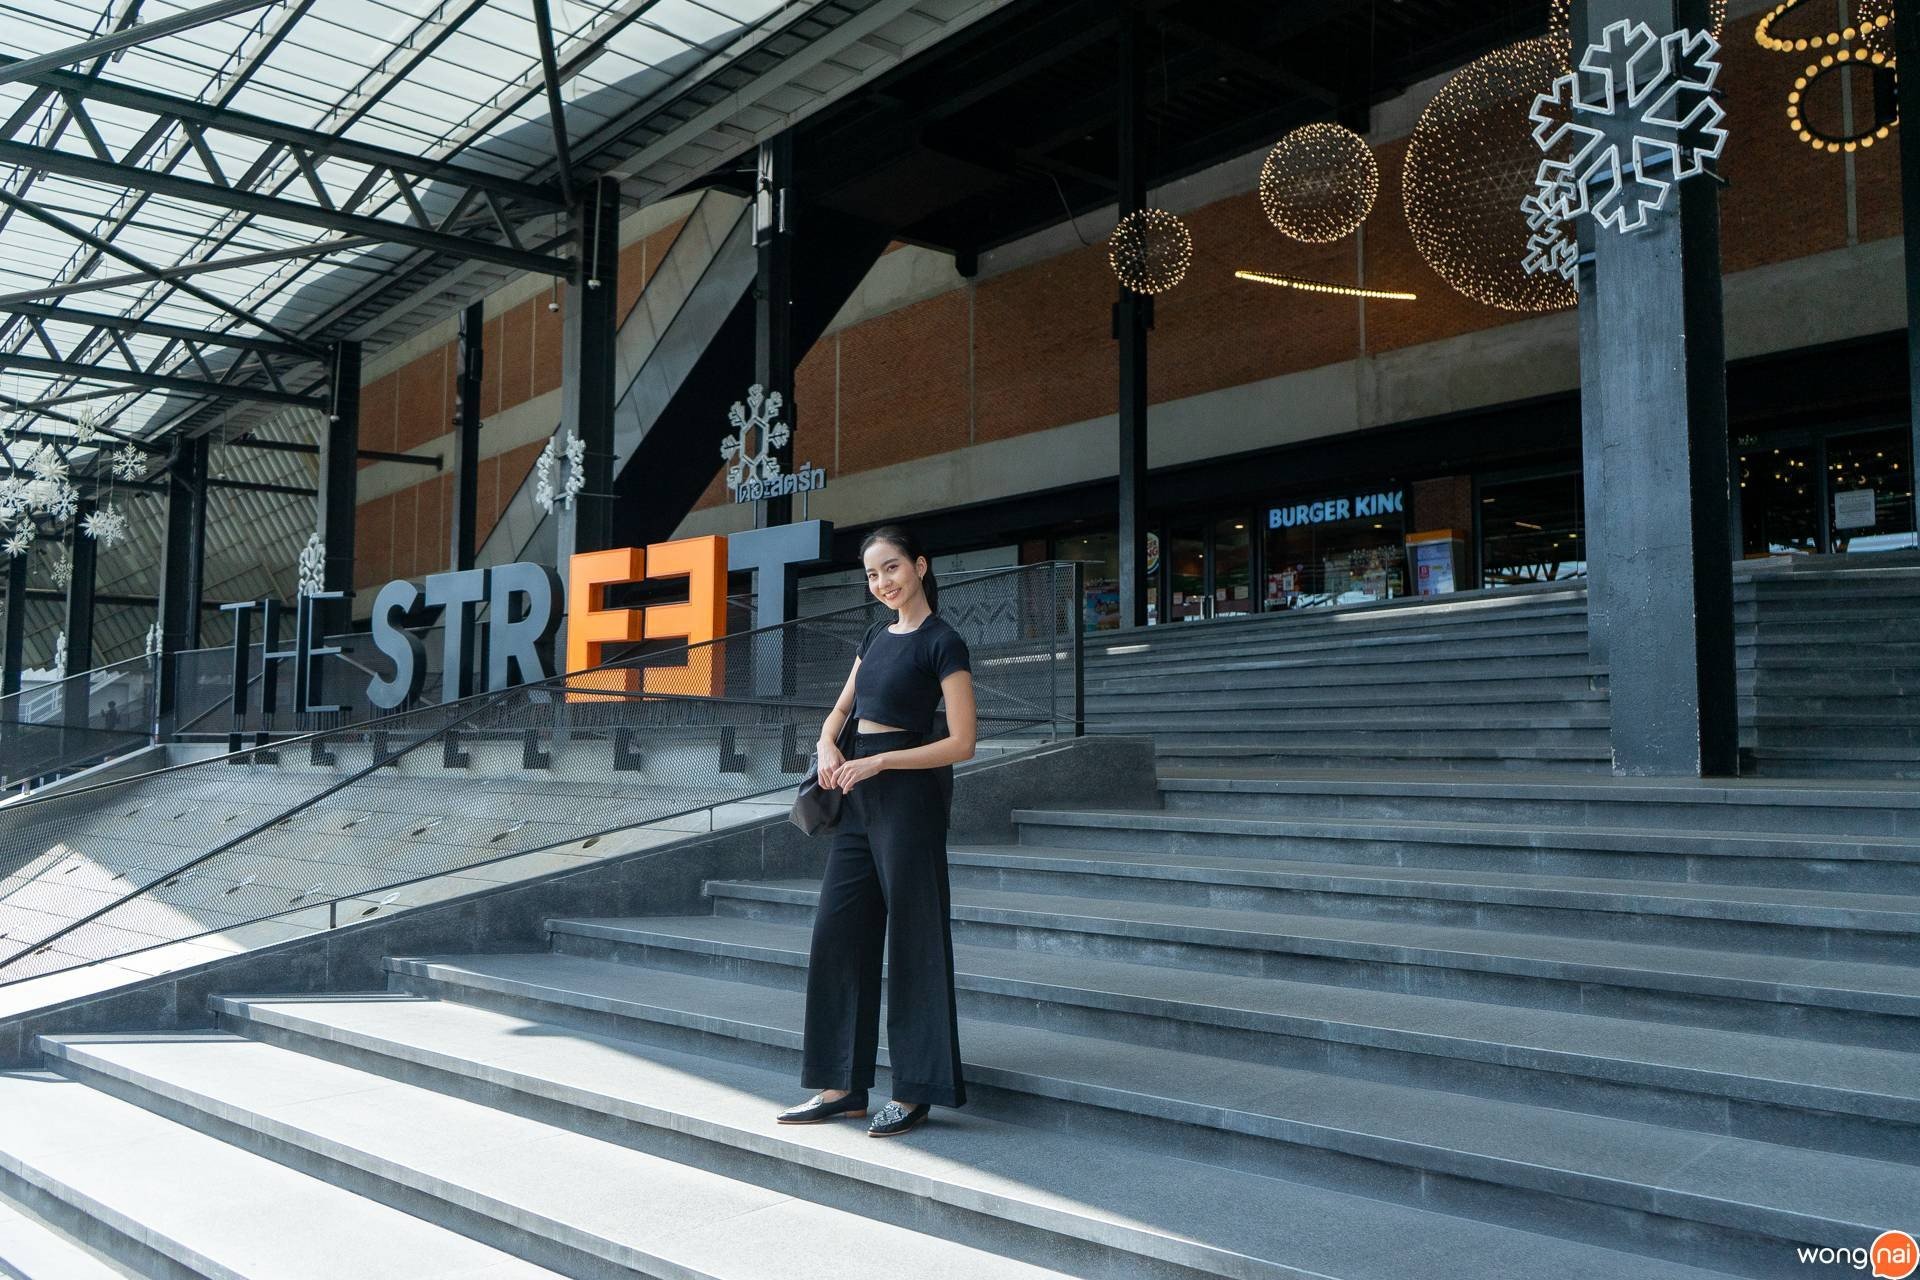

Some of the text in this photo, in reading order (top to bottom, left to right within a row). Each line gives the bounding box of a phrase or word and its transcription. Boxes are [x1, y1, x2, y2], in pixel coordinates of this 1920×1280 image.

[1268, 498, 1350, 530] BURGER
[220, 519, 833, 713] THE STREET
